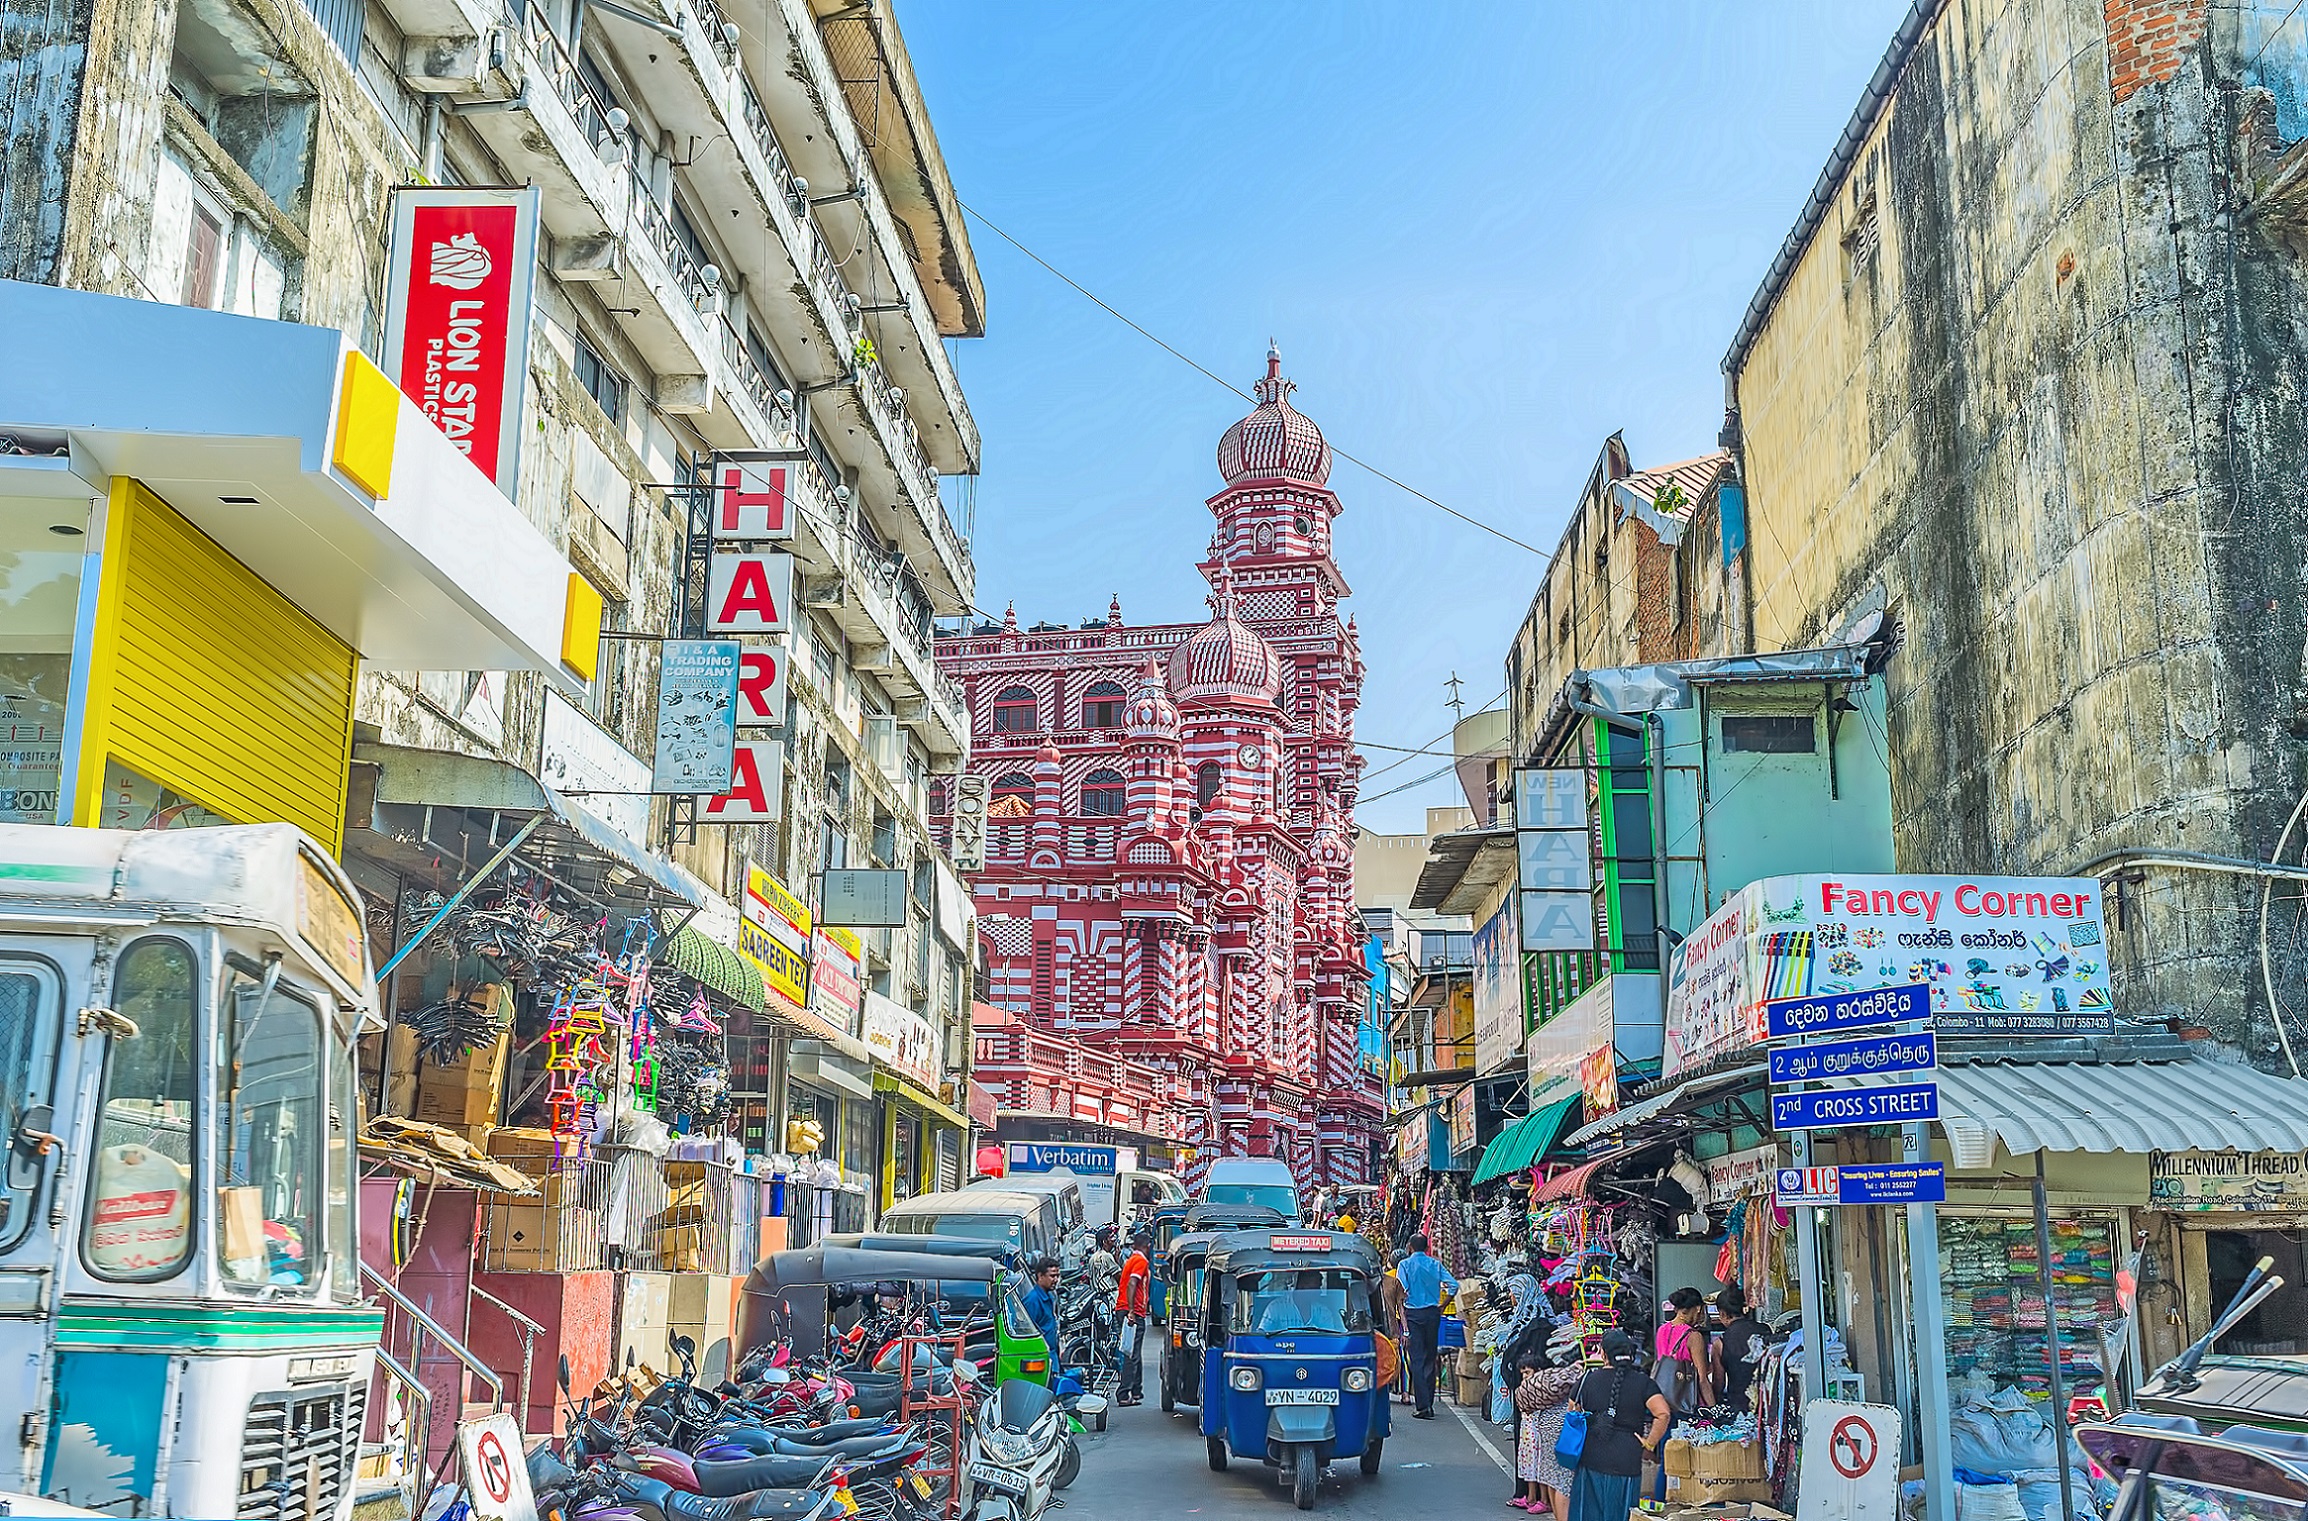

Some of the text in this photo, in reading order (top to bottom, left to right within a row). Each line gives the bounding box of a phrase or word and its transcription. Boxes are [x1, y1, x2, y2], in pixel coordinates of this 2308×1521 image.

[446, 300, 485, 371] LION
[668, 656, 732, 666] TRADING
[693, 645, 700, 654] &
[708, 645, 718, 654] A
[664, 667, 734, 677] COMPANY
[0, 752, 46, 761] OMPOSITE
[116, 778, 133, 829] VDF
[956, 777, 984, 854] SONY
[1820, 882, 2090, 924] Fancy Corner
[1686, 909, 1740, 969] Fancy Corner
[741, 924, 788, 979] SABREEN
[789, 956, 805, 990] TEX
[1785, 1003, 1829, 1030] දෙවන
[1935, 1016, 1969, 1028] Colombo
[1975, 1017, 1985, 1028] 11
[1987, 1016, 2006, 1028] Mob:
[2007, 1017, 2022, 1029] 077
[2062, 1017, 2076, 1029] 077
[1775, 1056, 1784, 1074] 2
[1790, 1051, 1818, 1077] ஆம்
[1778, 1092, 1932, 1121] 2nd CROSS STREET
[1032, 1147, 1108, 1167] Verbatim
[1711, 1160, 1754, 1186] Fancy Corner
[1805, 1168, 1837, 1194] LIC
[1868, 1171, 1884, 1179] Lives
[1889, 1169, 1917, 1180] Ensuring
[2156, 1196, 2200, 1204] Reclamation
[2202, 1196, 2225, 1205] Road,
[2226, 1196, 2260, 1204] Colombo
[1273, 1236, 1329, 1246] METERED TAXI
